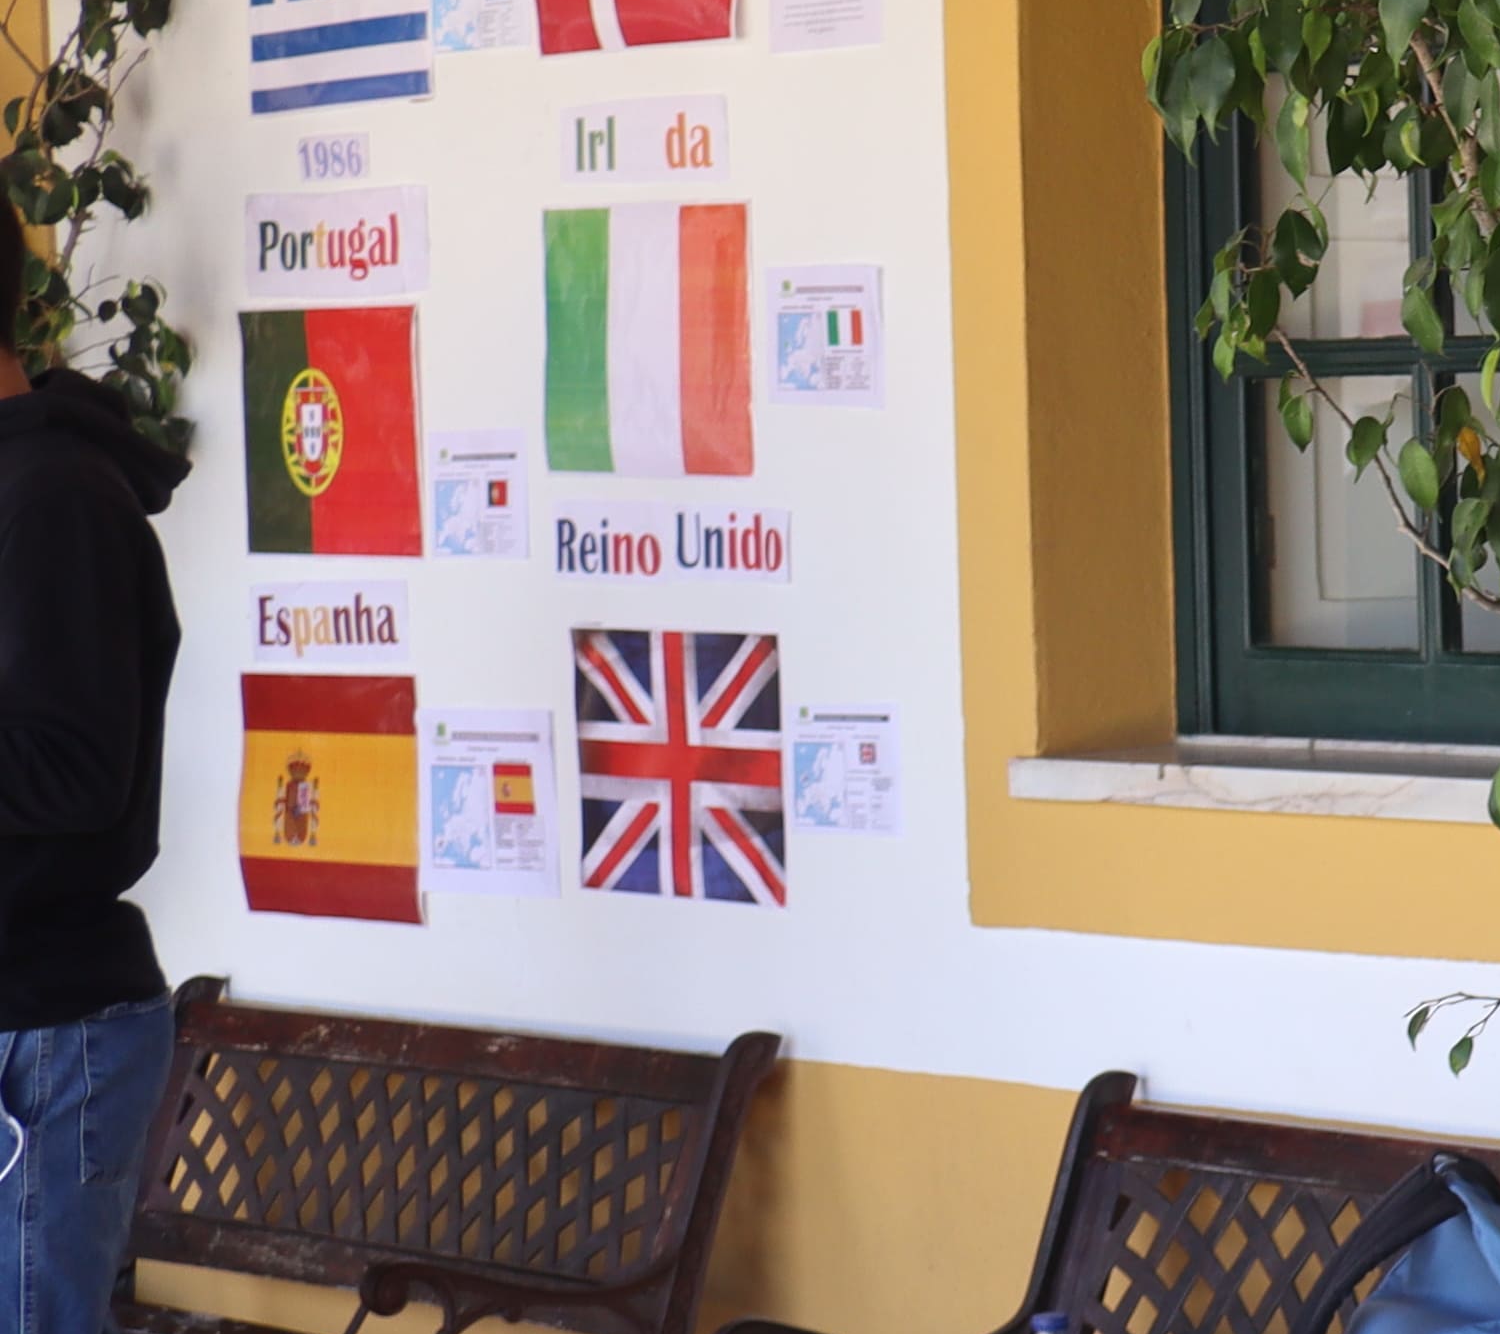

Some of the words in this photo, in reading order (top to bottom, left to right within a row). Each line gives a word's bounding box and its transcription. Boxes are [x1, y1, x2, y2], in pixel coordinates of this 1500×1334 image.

[300, 139, 361, 178] 1986
[259, 214, 399, 279] Portugal
[557, 519, 662, 577] Reino
[677, 512, 783, 575] Unido
[258, 596, 397, 658] Espanha
